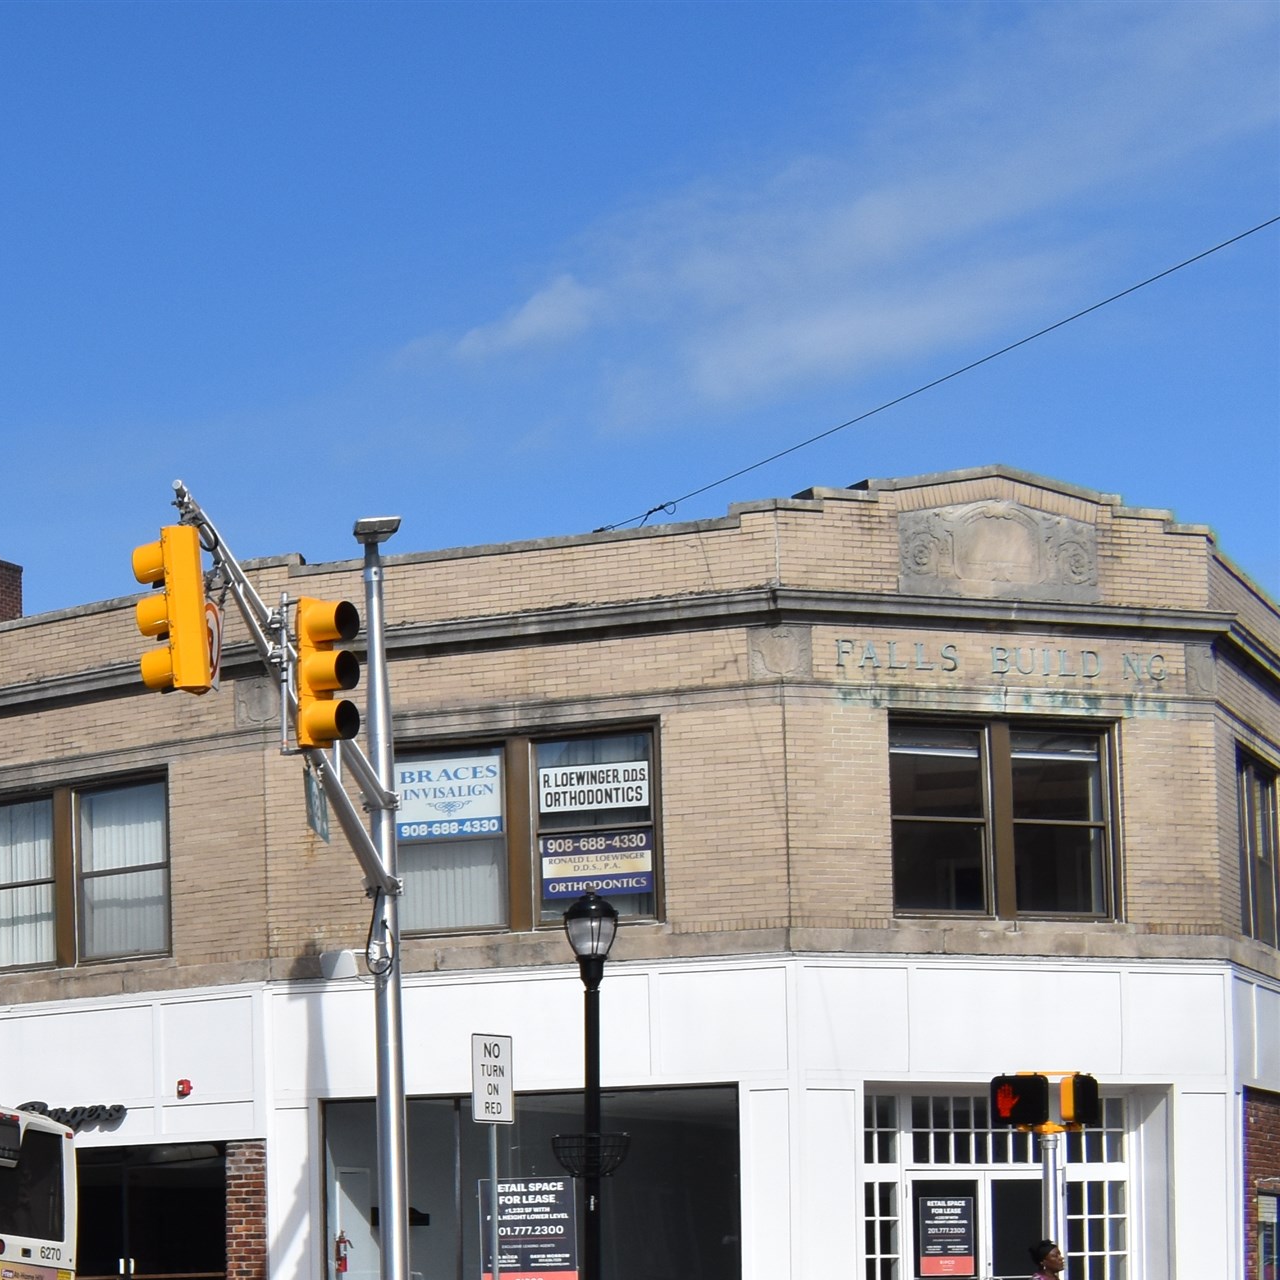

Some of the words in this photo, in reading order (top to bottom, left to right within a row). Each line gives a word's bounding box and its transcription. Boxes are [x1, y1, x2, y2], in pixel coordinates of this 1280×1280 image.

[835, 639, 960, 672] FALLS
[991, 645, 1167, 681] BUILDNG
[400, 764, 497, 784] BRACES
[543, 773, 552, 788] R.
[403, 783, 494, 800] INVISALIGN
[545, 786, 643, 808] ORTHODONTICS
[401, 819, 498, 837] 908-688-4330
[547, 833, 646, 853] 908-688-4330
[548, 856, 585, 865] RONALD
[595, 852, 645, 863] LOEWINGER
[604, 862, 621, 870] P.A.
[549, 877, 647, 893] ORTHODONTICS
[484, 1042, 500, 1059] NO
[481, 1064, 504, 1077] TURN
[487, 1083, 499, 1095] ON
[485, 1102, 502, 1114] RED
[497, 1183, 527, 1193] ETAIL
[528, 1182, 564, 1192] SPACE
[499, 1195, 520, 1205] FOR
[522, 1194, 556, 1204] LEASE
[498, 1225, 564, 1236] 01.777.2300
[40, 1246, 61, 1261] 6270
